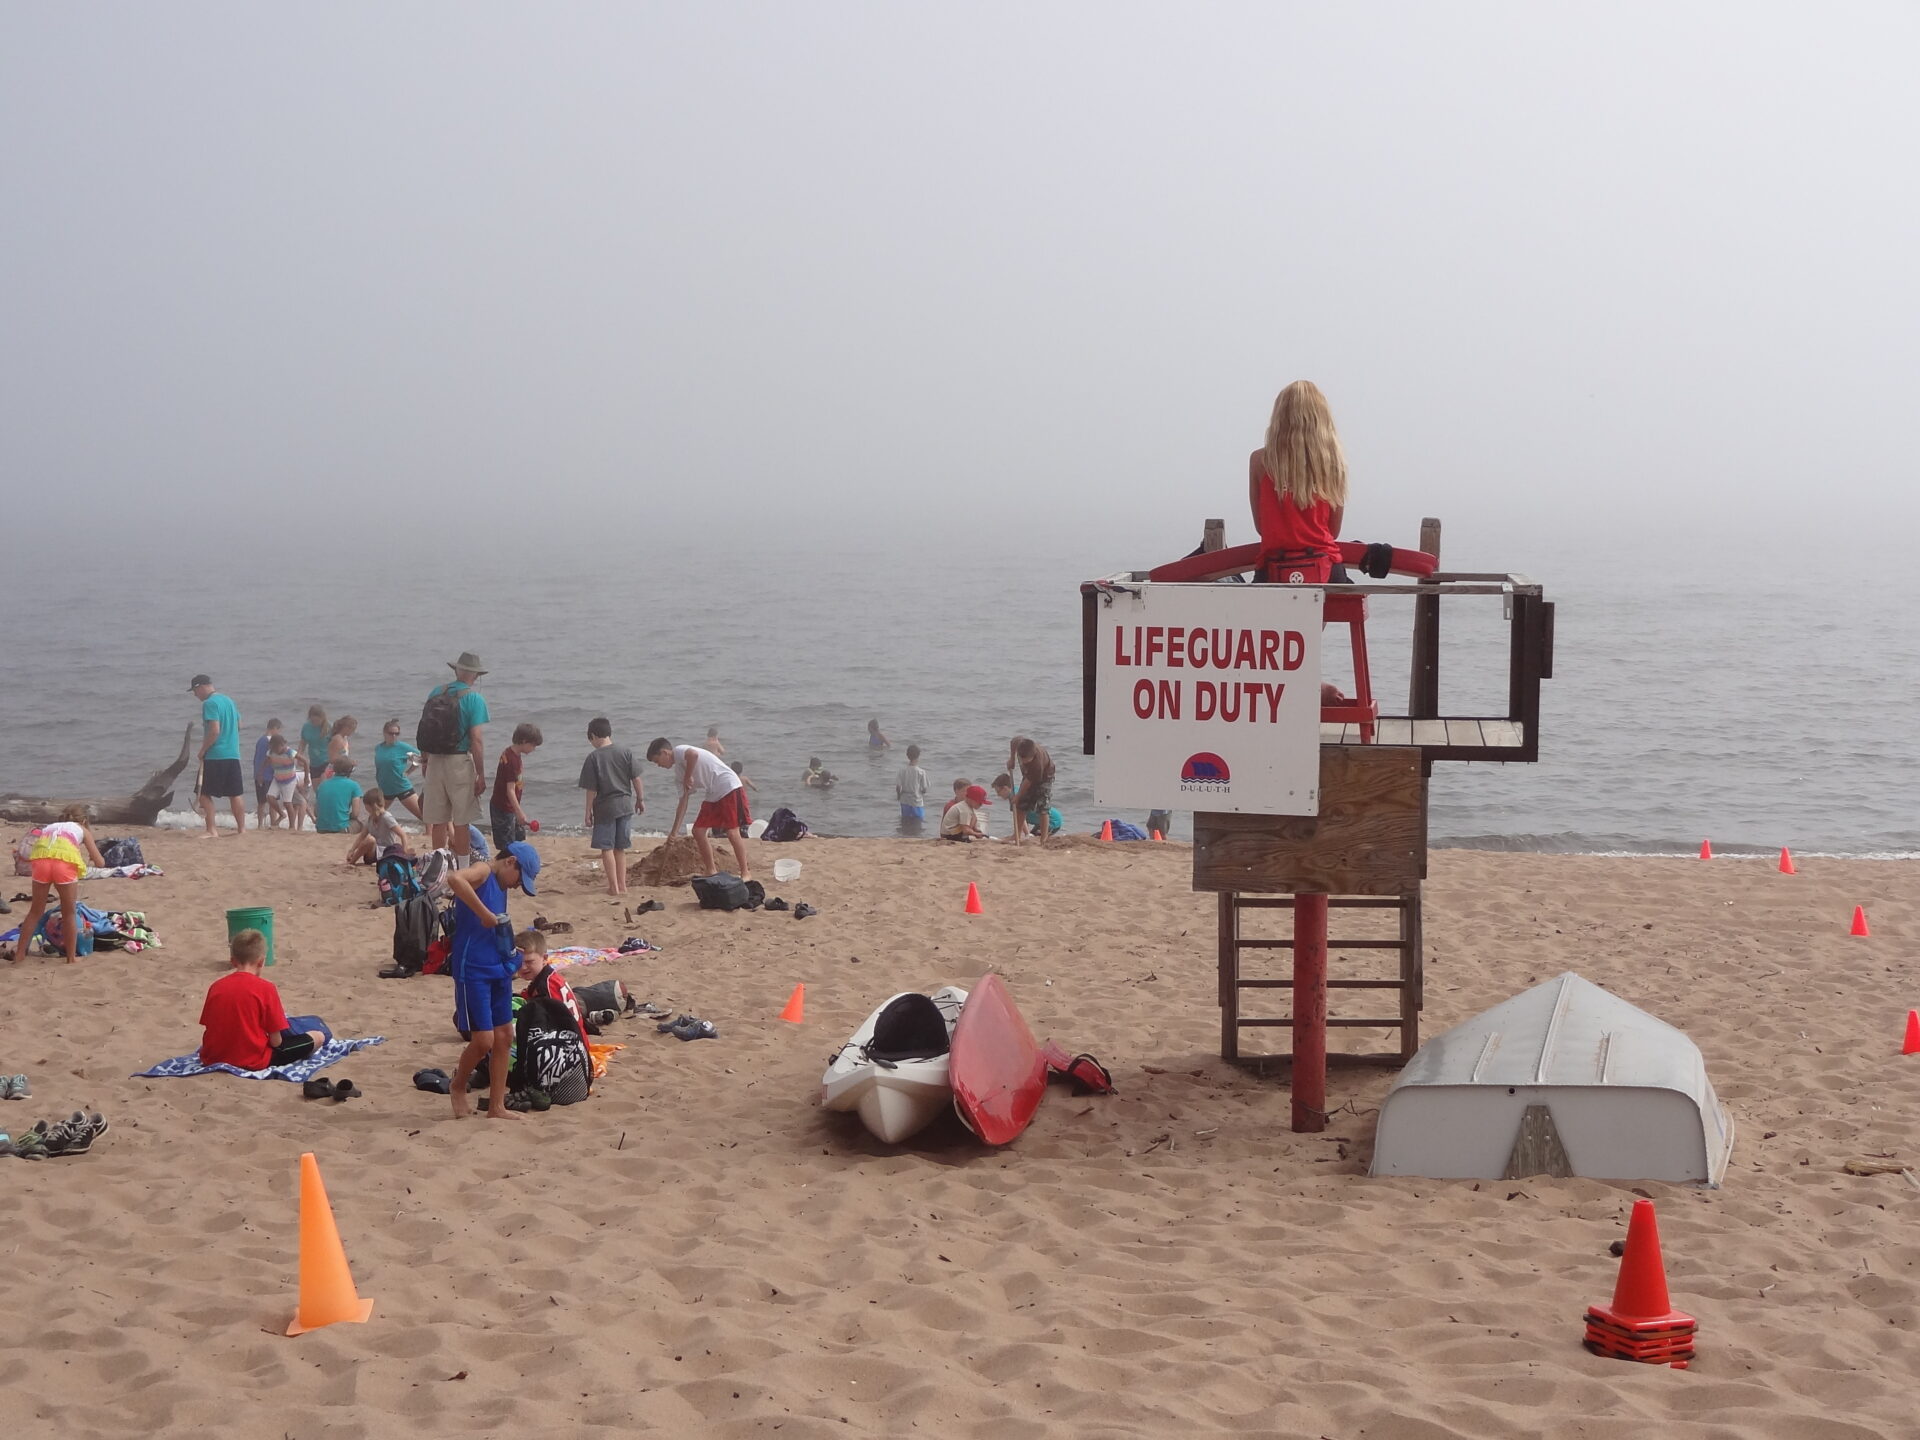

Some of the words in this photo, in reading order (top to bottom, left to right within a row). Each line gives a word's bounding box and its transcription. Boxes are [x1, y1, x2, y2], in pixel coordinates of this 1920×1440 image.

[1115, 625, 1305, 671] LIFEGUARD
[1133, 679, 1181, 720] ON
[1195, 681, 1285, 723] DUTY
